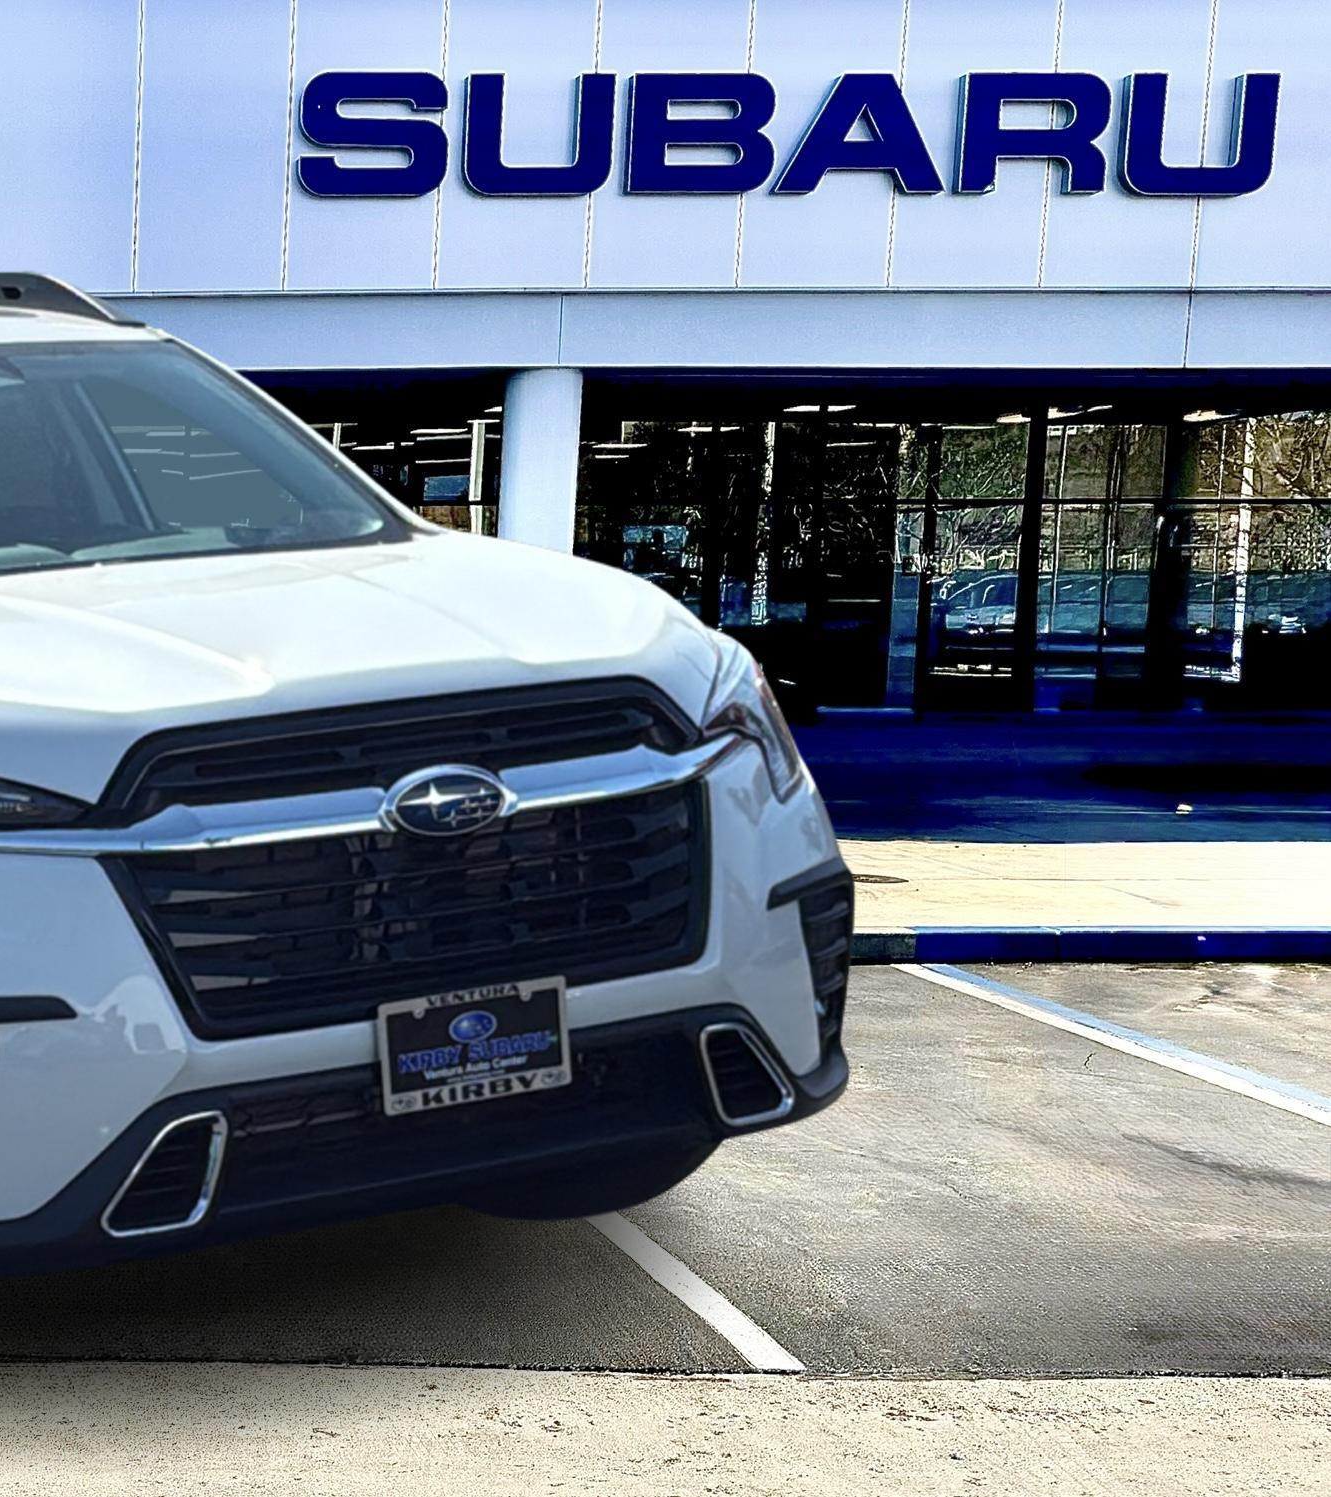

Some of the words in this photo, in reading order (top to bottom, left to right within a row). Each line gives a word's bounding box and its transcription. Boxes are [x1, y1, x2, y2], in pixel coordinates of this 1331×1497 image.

[297, 70, 1282, 197] SUBARU
[427, 984, 520, 1007] VENTURA
[398, 1045, 463, 1074] KIRBY
[469, 1030, 551, 1061] SUBARU
[466, 1060, 491, 1073] Auto
[492, 1055, 528, 1068] Center
[422, 1073, 538, 1107] KIRBY
